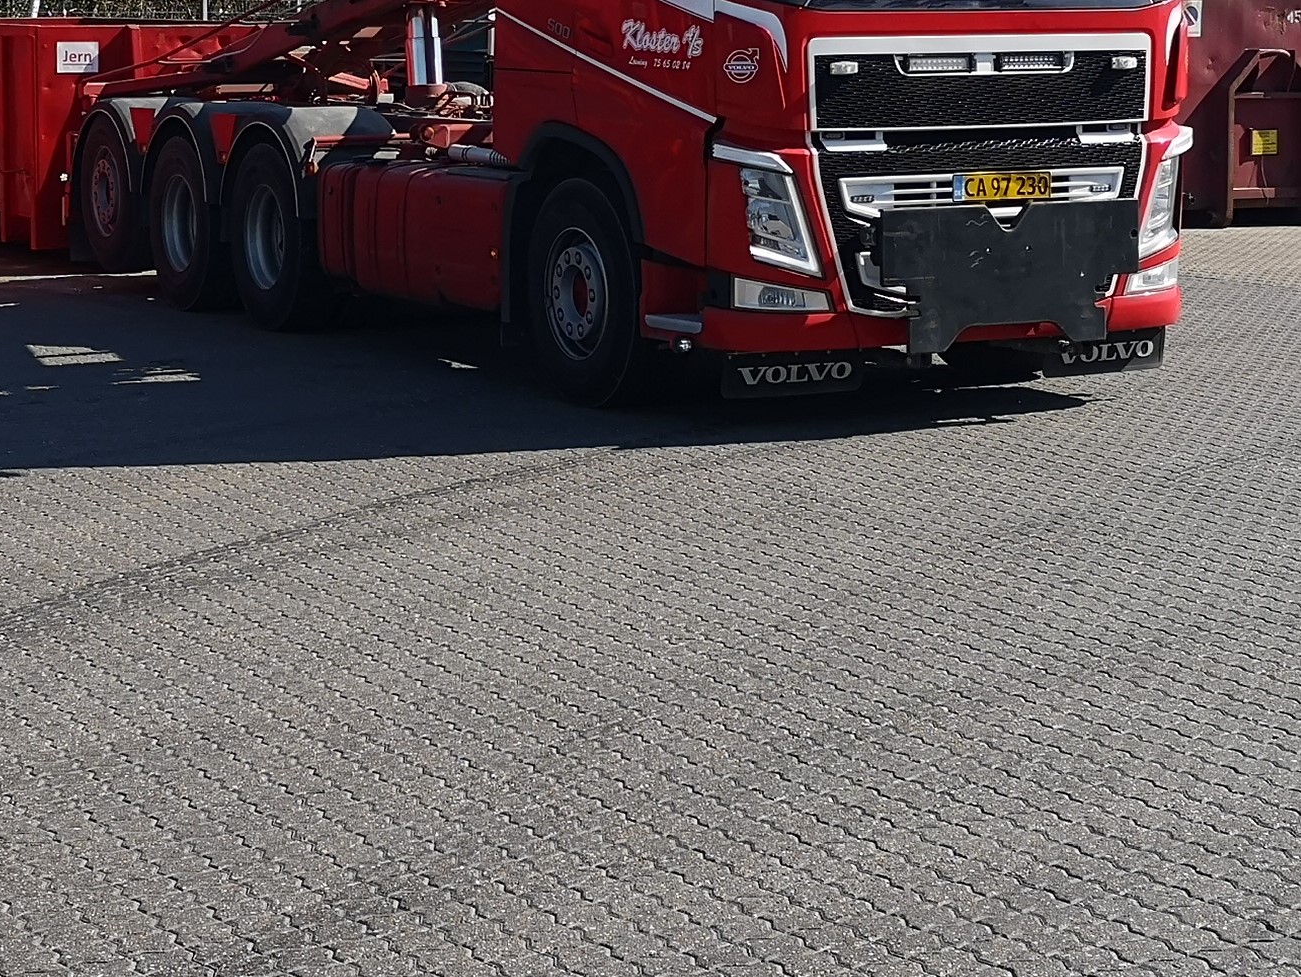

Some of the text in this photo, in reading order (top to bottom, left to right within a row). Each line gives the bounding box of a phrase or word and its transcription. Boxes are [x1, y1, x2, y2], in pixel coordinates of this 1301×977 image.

[547, 18, 571, 39] 500
[621, 18, 704, 59] Kloster A/S
[62, 50, 93, 62] Jern
[964, 176, 1049, 197] CA 97 230
[737, 361, 852, 385] VOLVO
